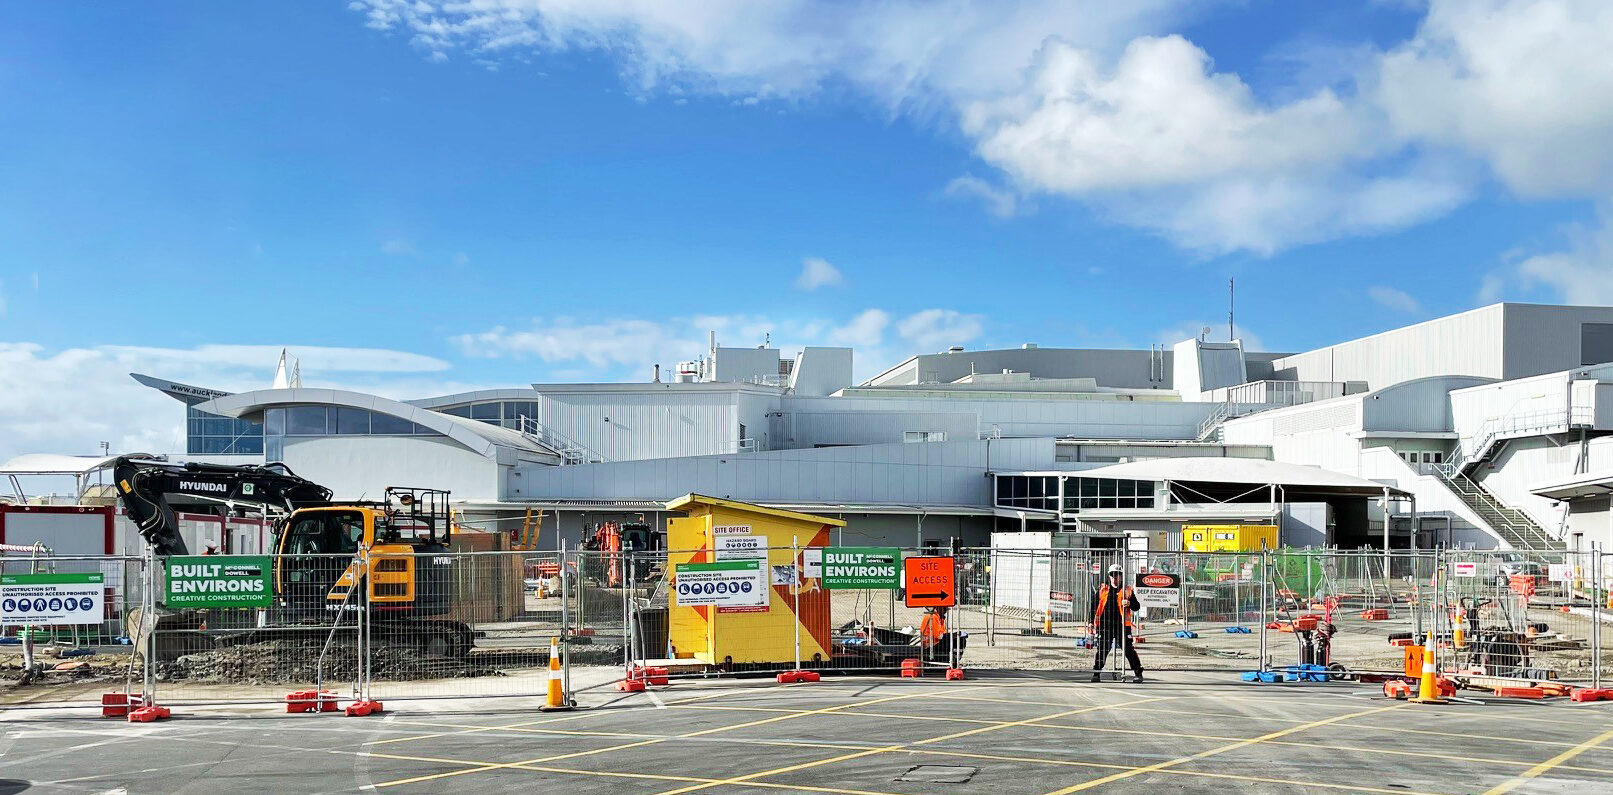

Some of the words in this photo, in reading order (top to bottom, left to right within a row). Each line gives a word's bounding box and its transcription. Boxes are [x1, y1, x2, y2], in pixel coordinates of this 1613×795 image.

[180, 481, 227, 492] HYUNDAI
[714, 526, 727, 534] SITE
[825, 553, 864, 564] BUILT
[170, 564, 222, 577] BUILT
[825, 565, 896, 577] ENVIRONS
[920, 562, 938, 571] SITE
[913, 575, 948, 584] ACCESS
[170, 579, 265, 593] ENVIRONS
